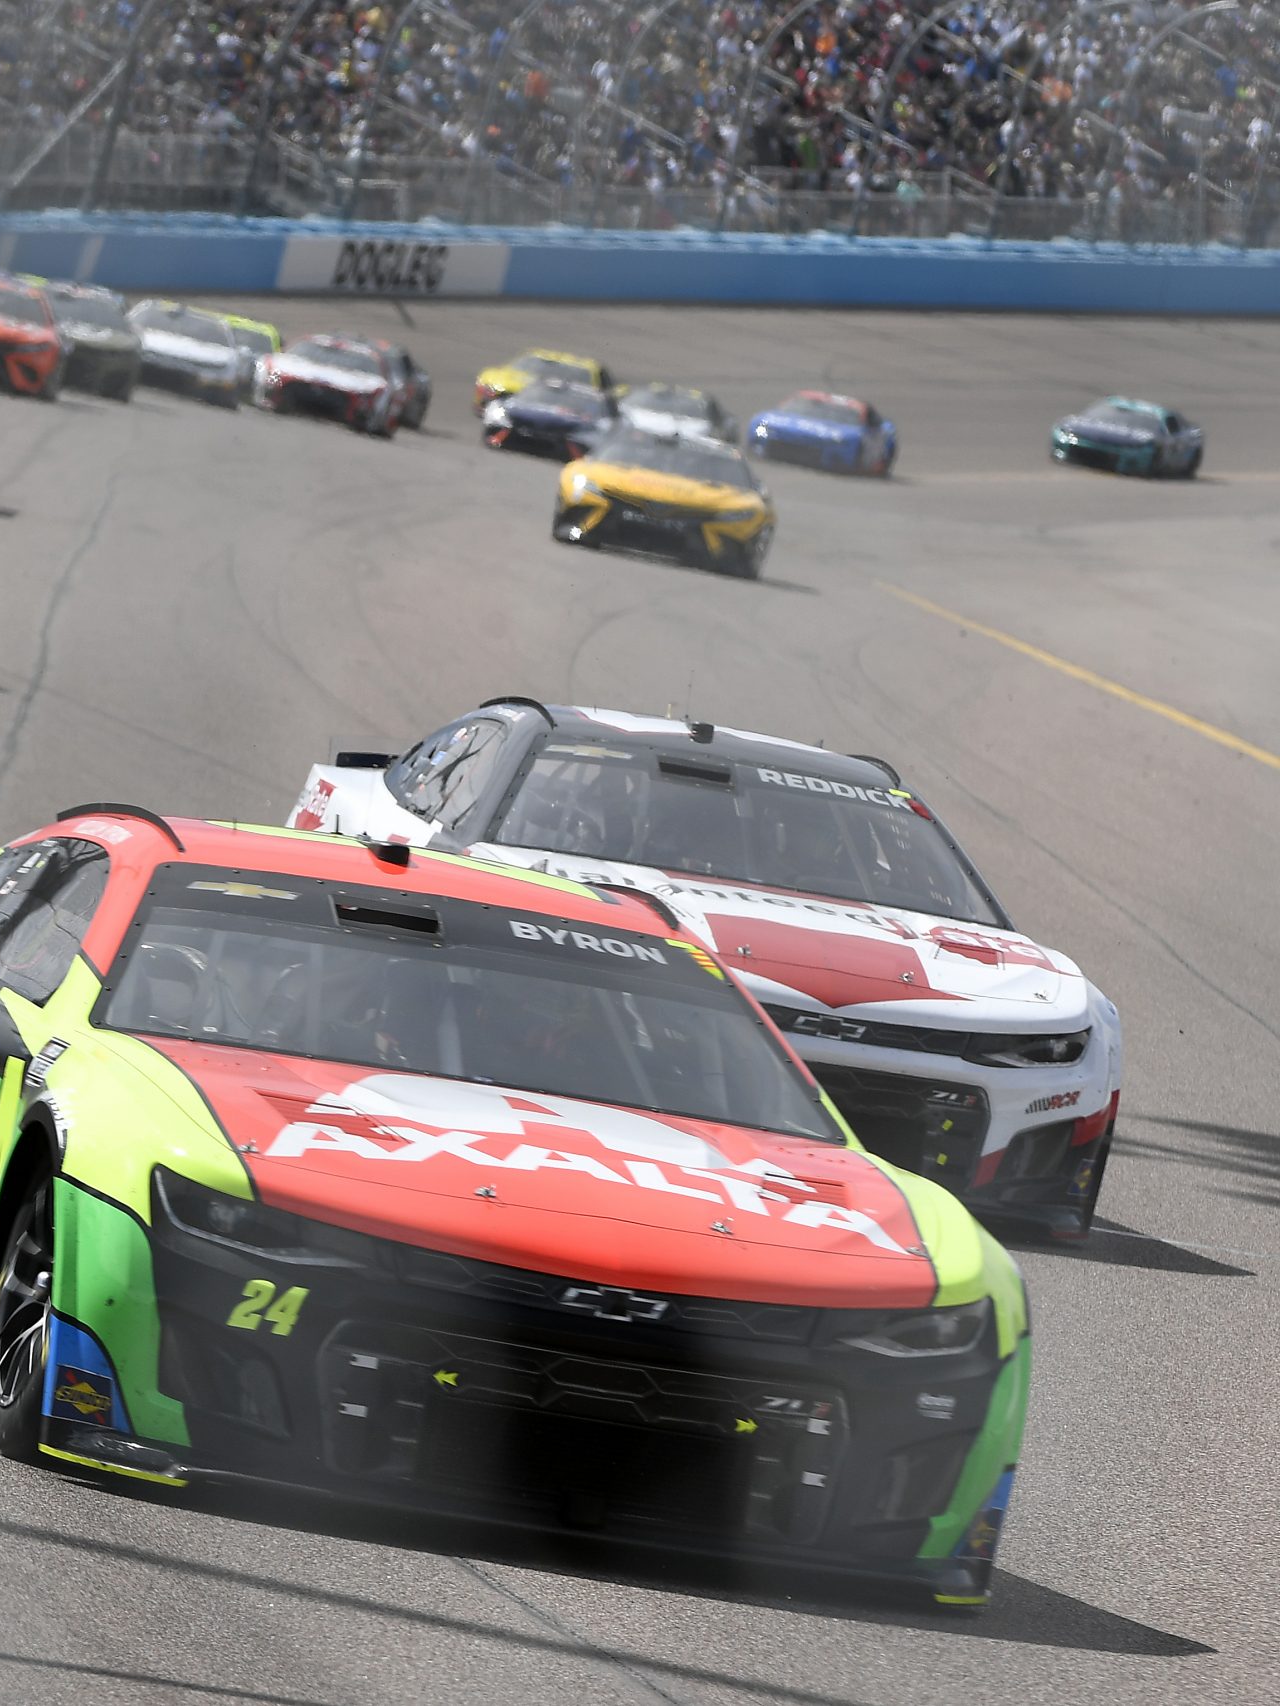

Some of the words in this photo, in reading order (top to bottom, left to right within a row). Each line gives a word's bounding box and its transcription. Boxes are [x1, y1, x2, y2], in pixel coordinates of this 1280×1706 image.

[757, 767, 916, 813] REDDICK
[509, 919, 668, 965] BYRON
[264, 1120, 909, 1256] AXALTA
[226, 1279, 310, 1337] 24
